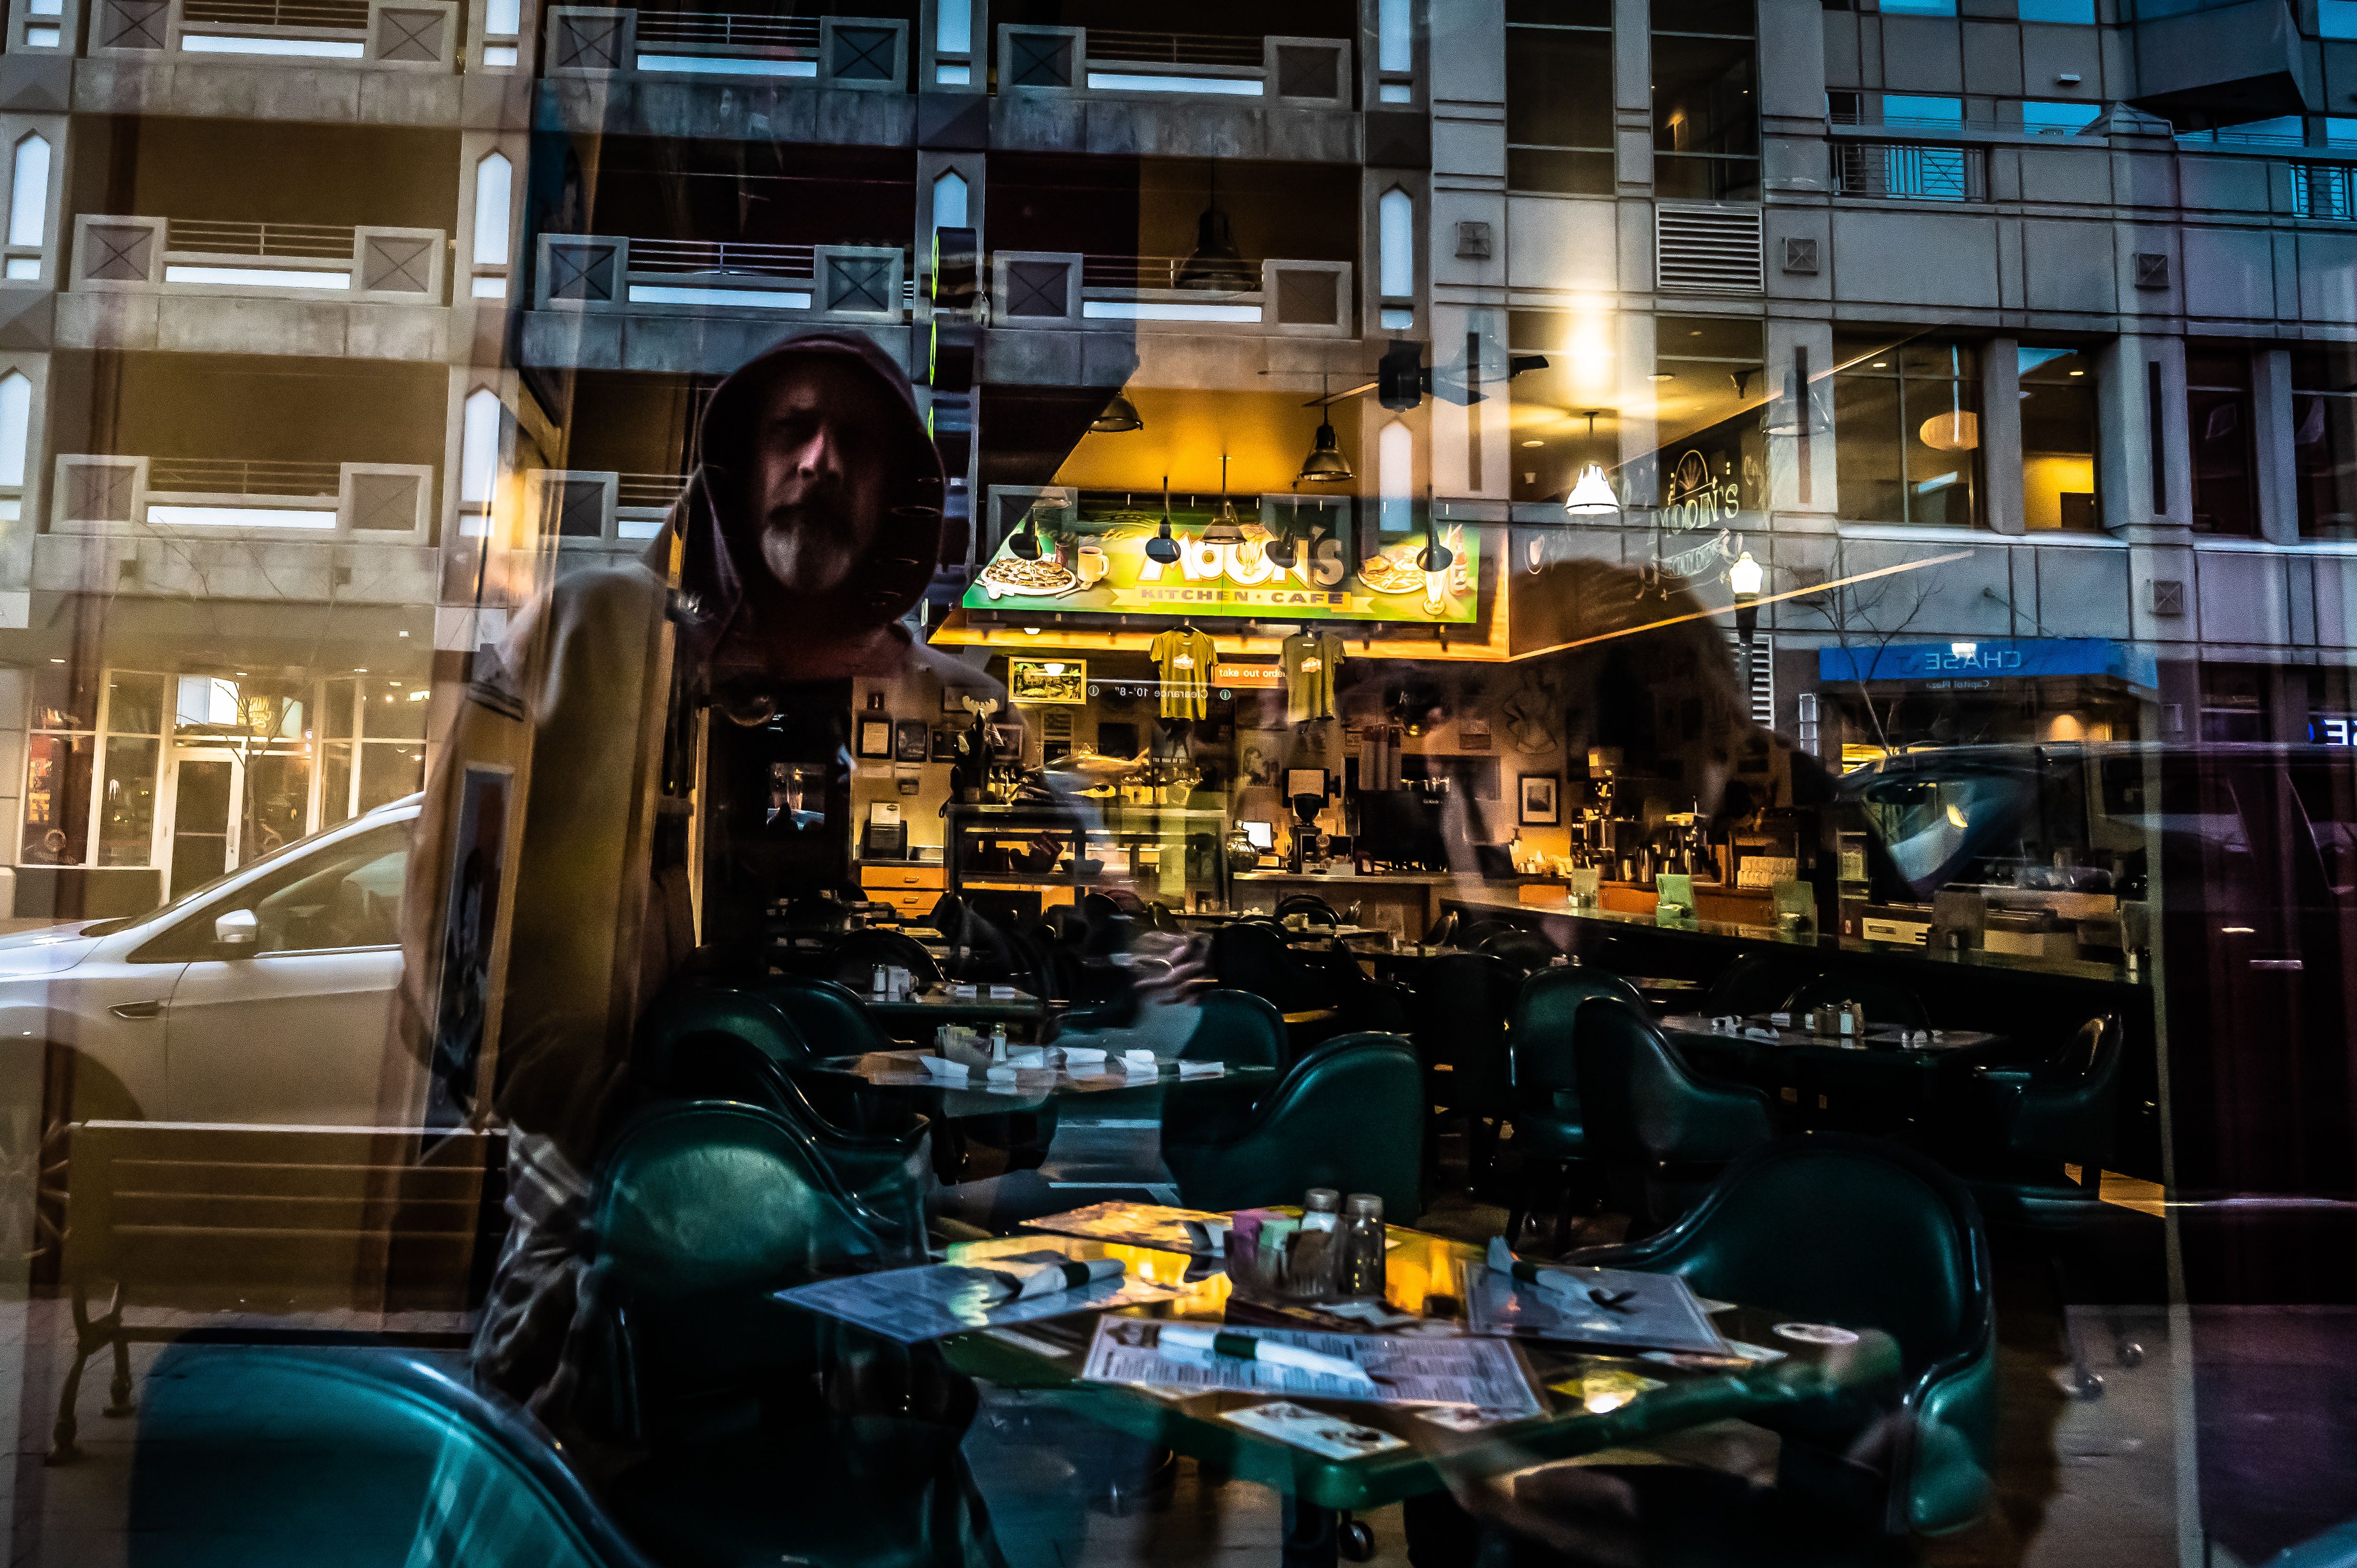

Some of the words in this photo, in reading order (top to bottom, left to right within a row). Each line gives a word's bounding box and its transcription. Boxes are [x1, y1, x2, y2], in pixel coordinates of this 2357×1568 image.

[1141, 589, 1248, 602] KITCHEN
[1271, 591, 1344, 604] CAFE
[1219, 668, 1239, 677] take
[1243, 669, 1260, 677] out
